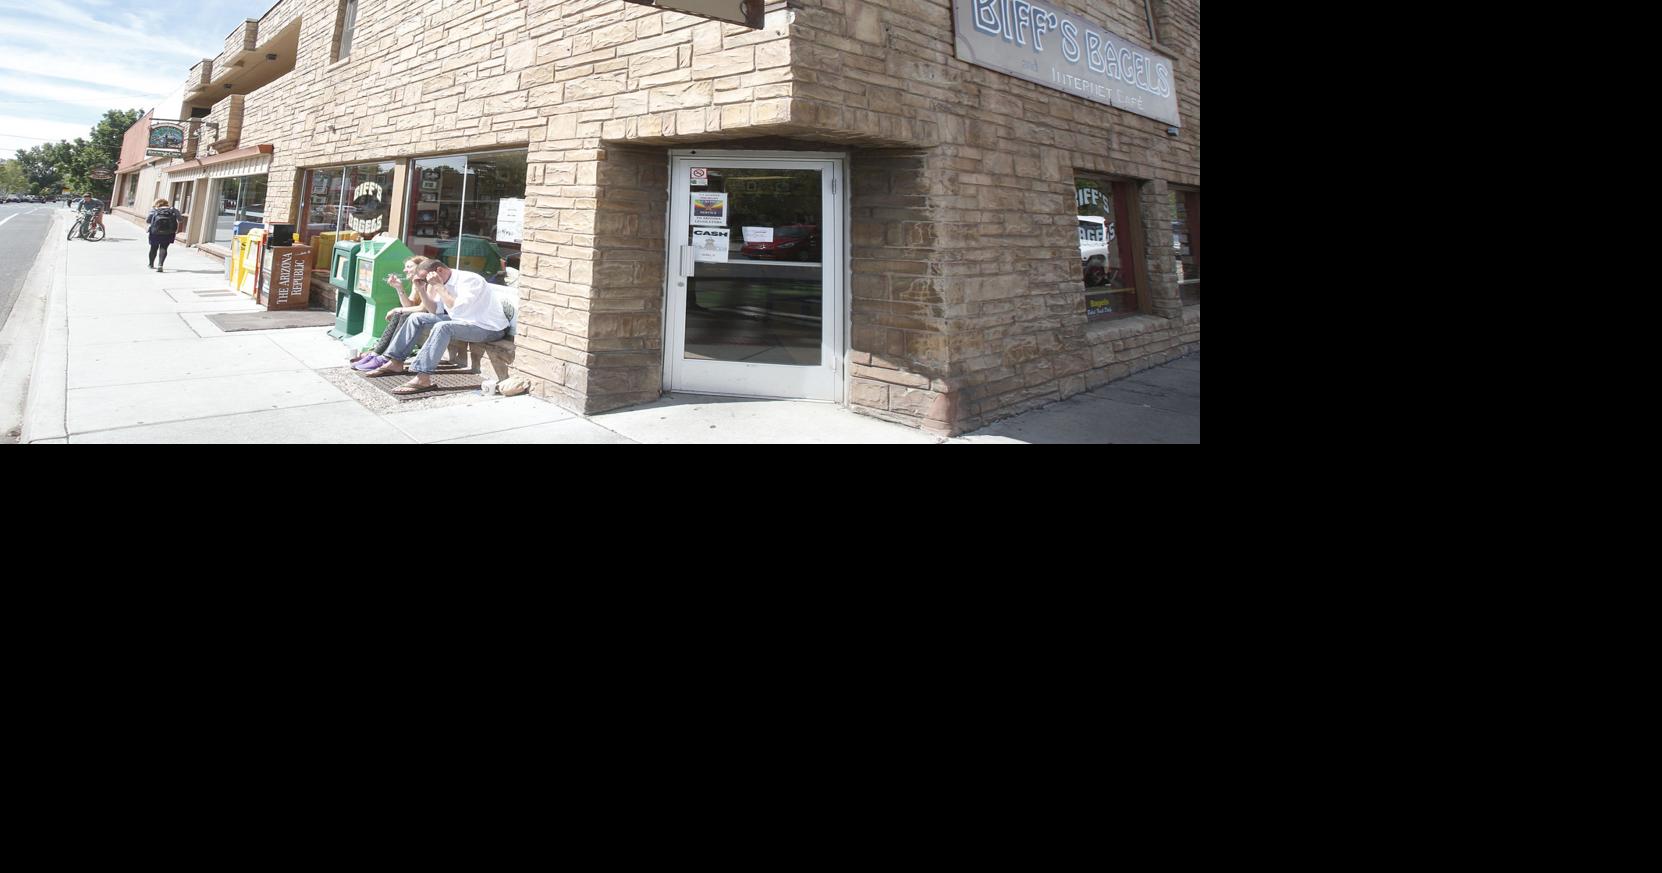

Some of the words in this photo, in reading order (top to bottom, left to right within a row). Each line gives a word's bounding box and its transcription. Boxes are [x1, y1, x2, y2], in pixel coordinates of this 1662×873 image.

[973, 0, 1080, 62] BIFF'S
[1085, 29, 1170, 98] BAGELS
[1075, 187, 1110, 214] IFF'S
[279, 252, 293, 286] ARIZONA
[291, 259, 305, 296] REPUBLIC
[277, 287, 289, 305] THE
